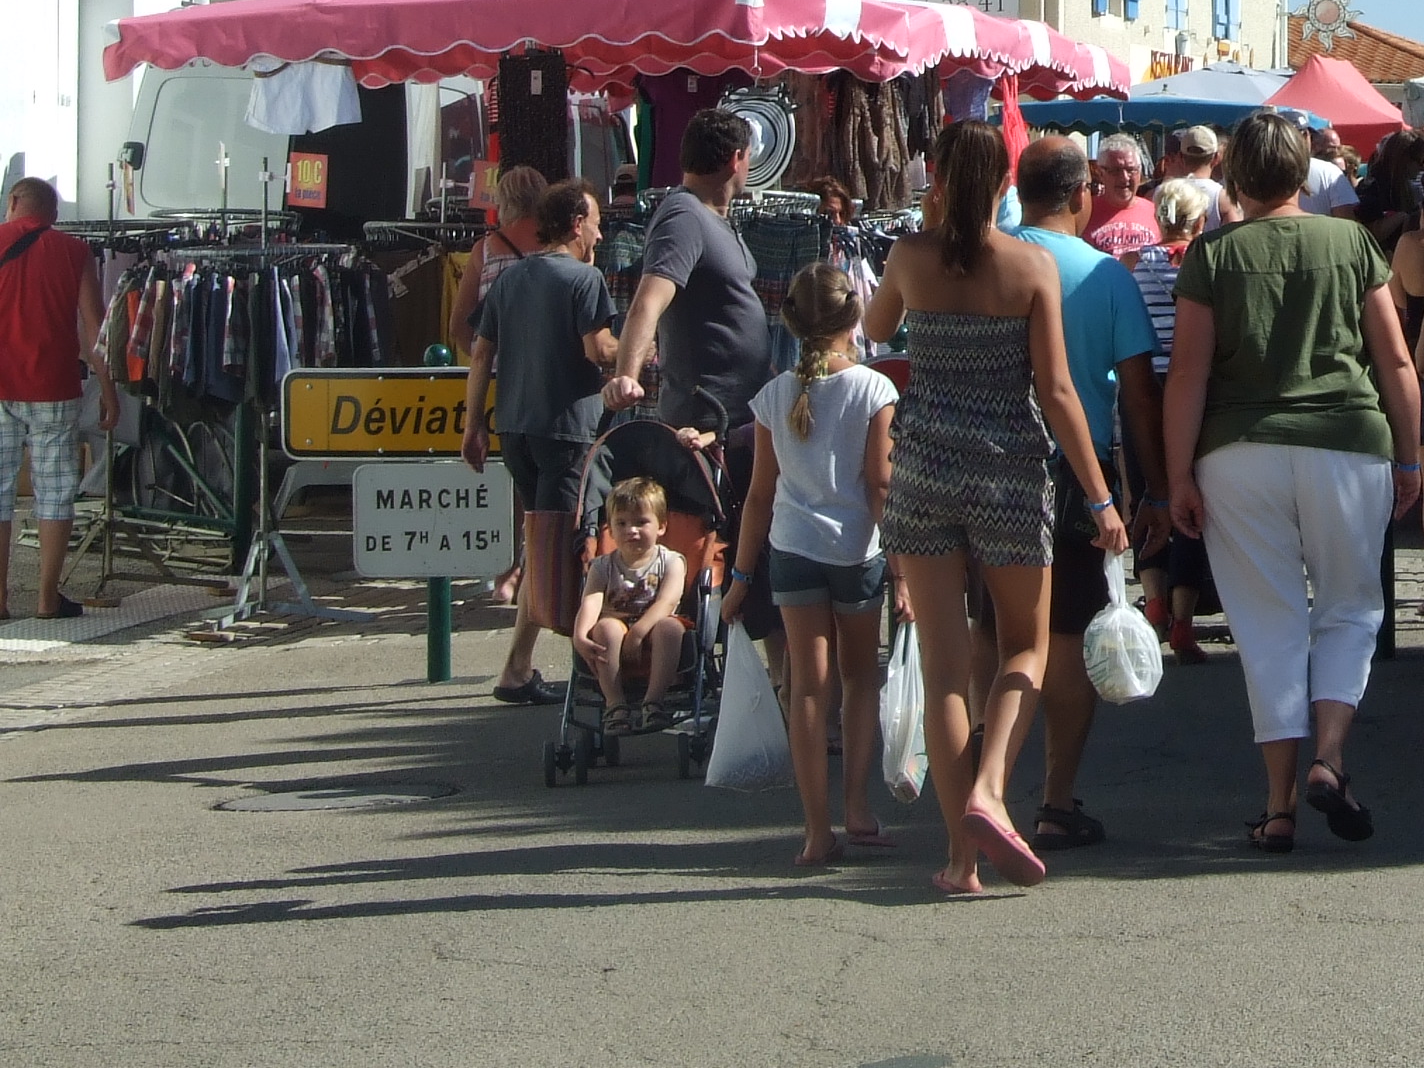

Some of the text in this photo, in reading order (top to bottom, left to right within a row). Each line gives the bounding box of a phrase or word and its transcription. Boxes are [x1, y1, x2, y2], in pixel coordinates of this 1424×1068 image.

[297, 160, 311, 183] 10
[331, 395, 496, 435] Déviat
[376, 484, 489, 509] MARCHÉ
[366, 529, 500, 552] DE 7H A 15H
